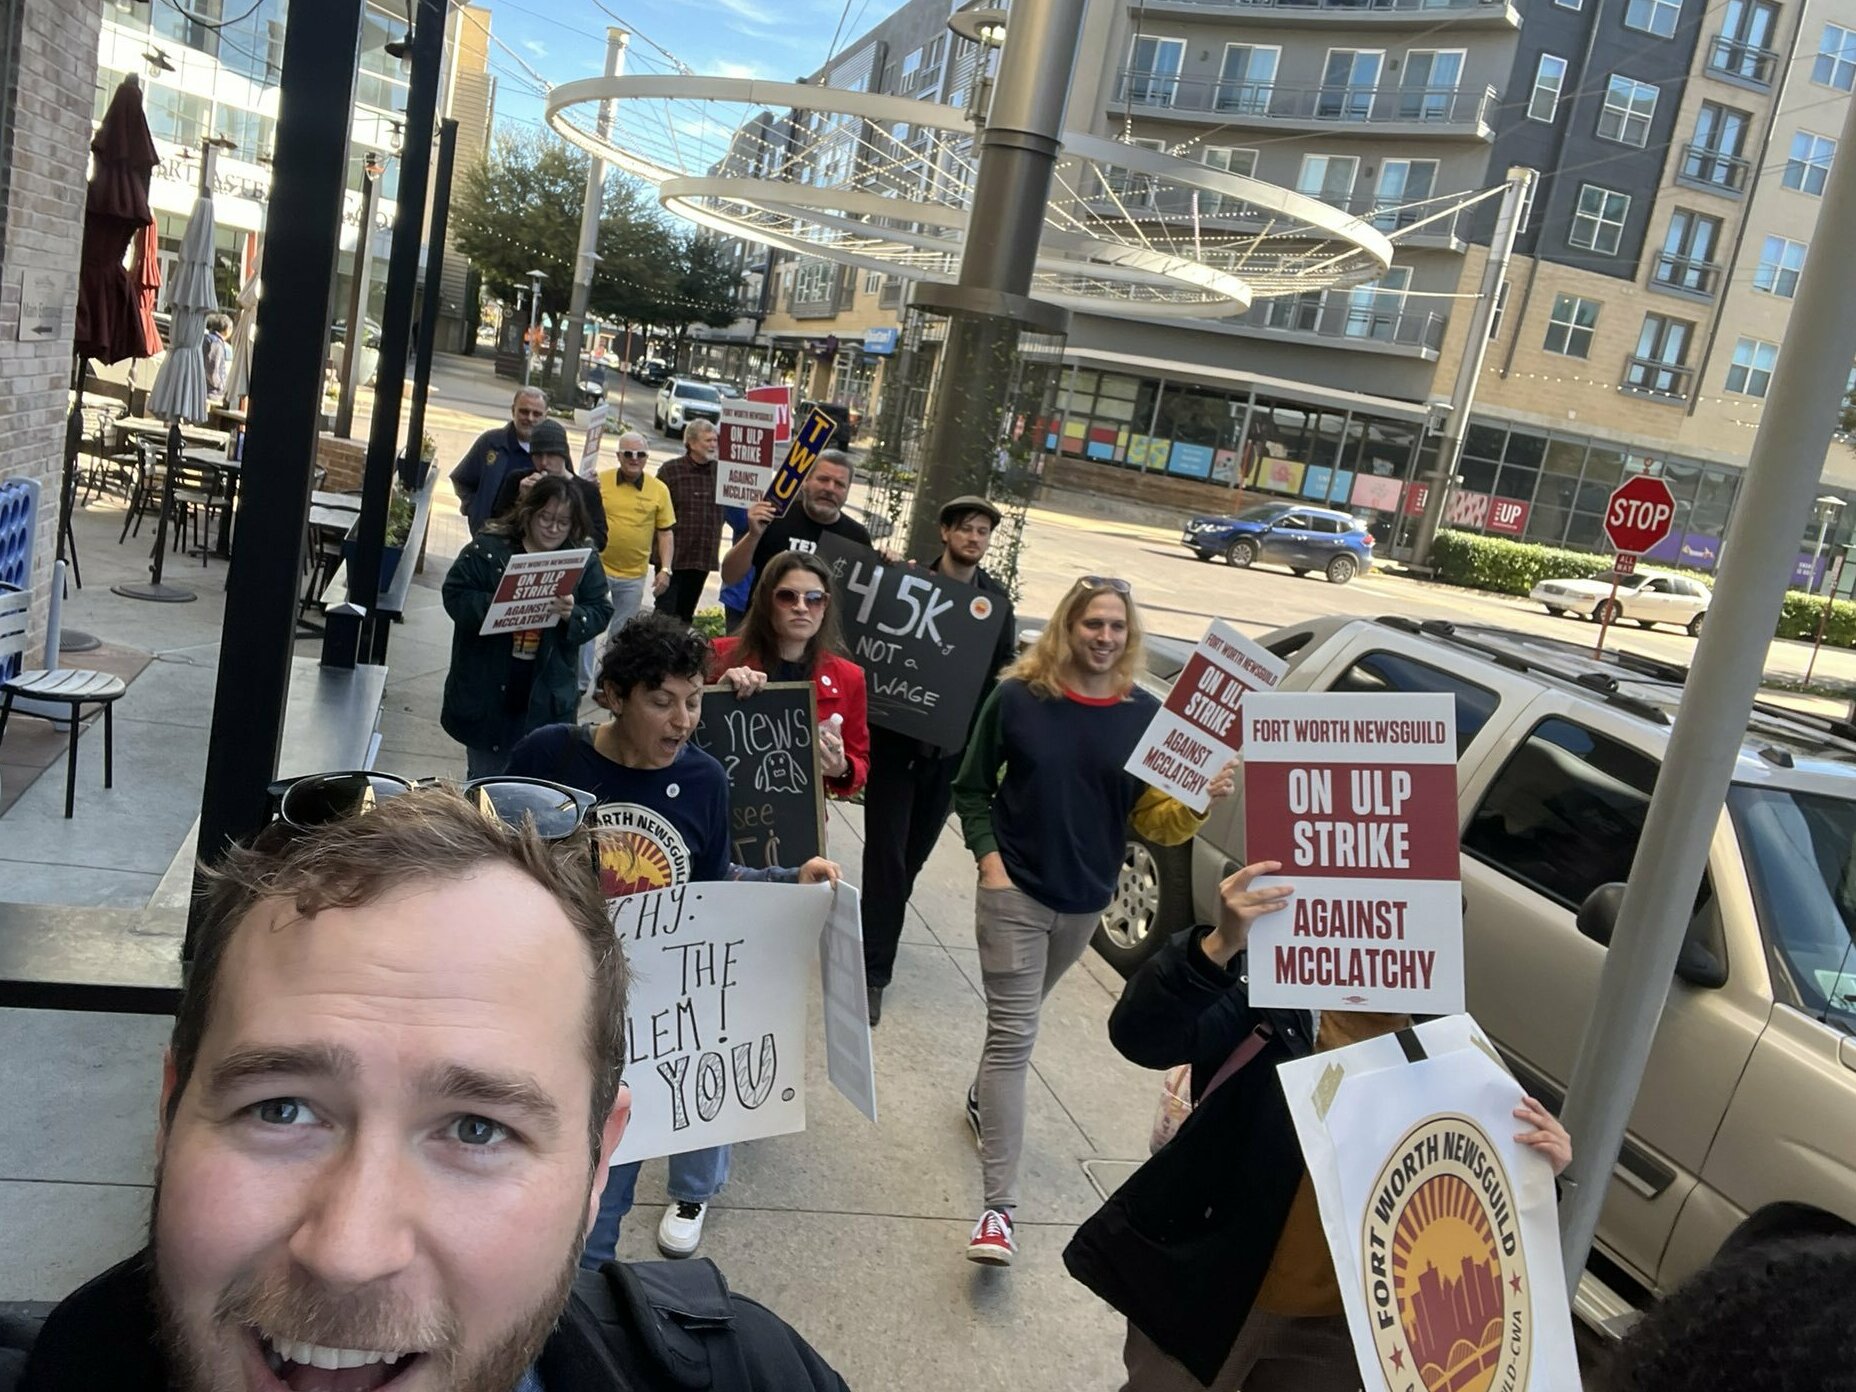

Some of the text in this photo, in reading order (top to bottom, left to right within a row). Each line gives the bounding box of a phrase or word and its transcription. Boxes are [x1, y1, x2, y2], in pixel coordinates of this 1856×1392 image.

[730, 425, 763, 445] ON ULP
[730, 443, 762, 463] STRIKE
[775, 415, 829, 499] TWU
[723, 484, 764, 502] MCCLATCHY
[728, 469, 758, 486] AGAINST
[1500, 503, 1522, 524] UP
[1610, 498, 1670, 532] STOP
[511, 562, 527, 570] FORT
[527, 560, 549, 568] WORTH
[1616, 564, 1632, 573] WAY
[1619, 555, 1633, 564] ALL
[512, 583, 559, 600] STRIKE
[517, 570, 566, 587] ON ULP
[492, 613, 552, 629] MCCLATCHY
[504, 602, 548, 617] AGAINST
[856, 635, 919, 670] NOT a
[1206, 633, 1278, 687] FORT WORTH NEWSGUILD
[873, 672, 940, 707] WAGE
[1198, 665, 1225, 696] ON
[1184, 691, 1236, 737] STRIKE
[1253, 719, 1446, 744] FORT WORTH NEWSGUILD
[724, 708, 810, 756] news
[1163, 728, 1213, 769] AGAINST
[1142, 746, 1209, 796] MCCLATCHY
[1288, 768, 1412, 817] ON ULP
[733, 803, 775, 830] see
[1293, 820, 1411, 869] STRIKE
[610, 884, 703, 940] CHY:
[1293, 898, 1408, 940] AGAINST
[662, 938, 745, 996] THE
[1274, 945, 1436, 990] MCCLATCHY
[627, 989, 728, 1065] LEM!
[656, 1032, 796, 1131] YOU.
[1369, 1131, 1517, 1330] FORT WORTH NEWSGUILD
